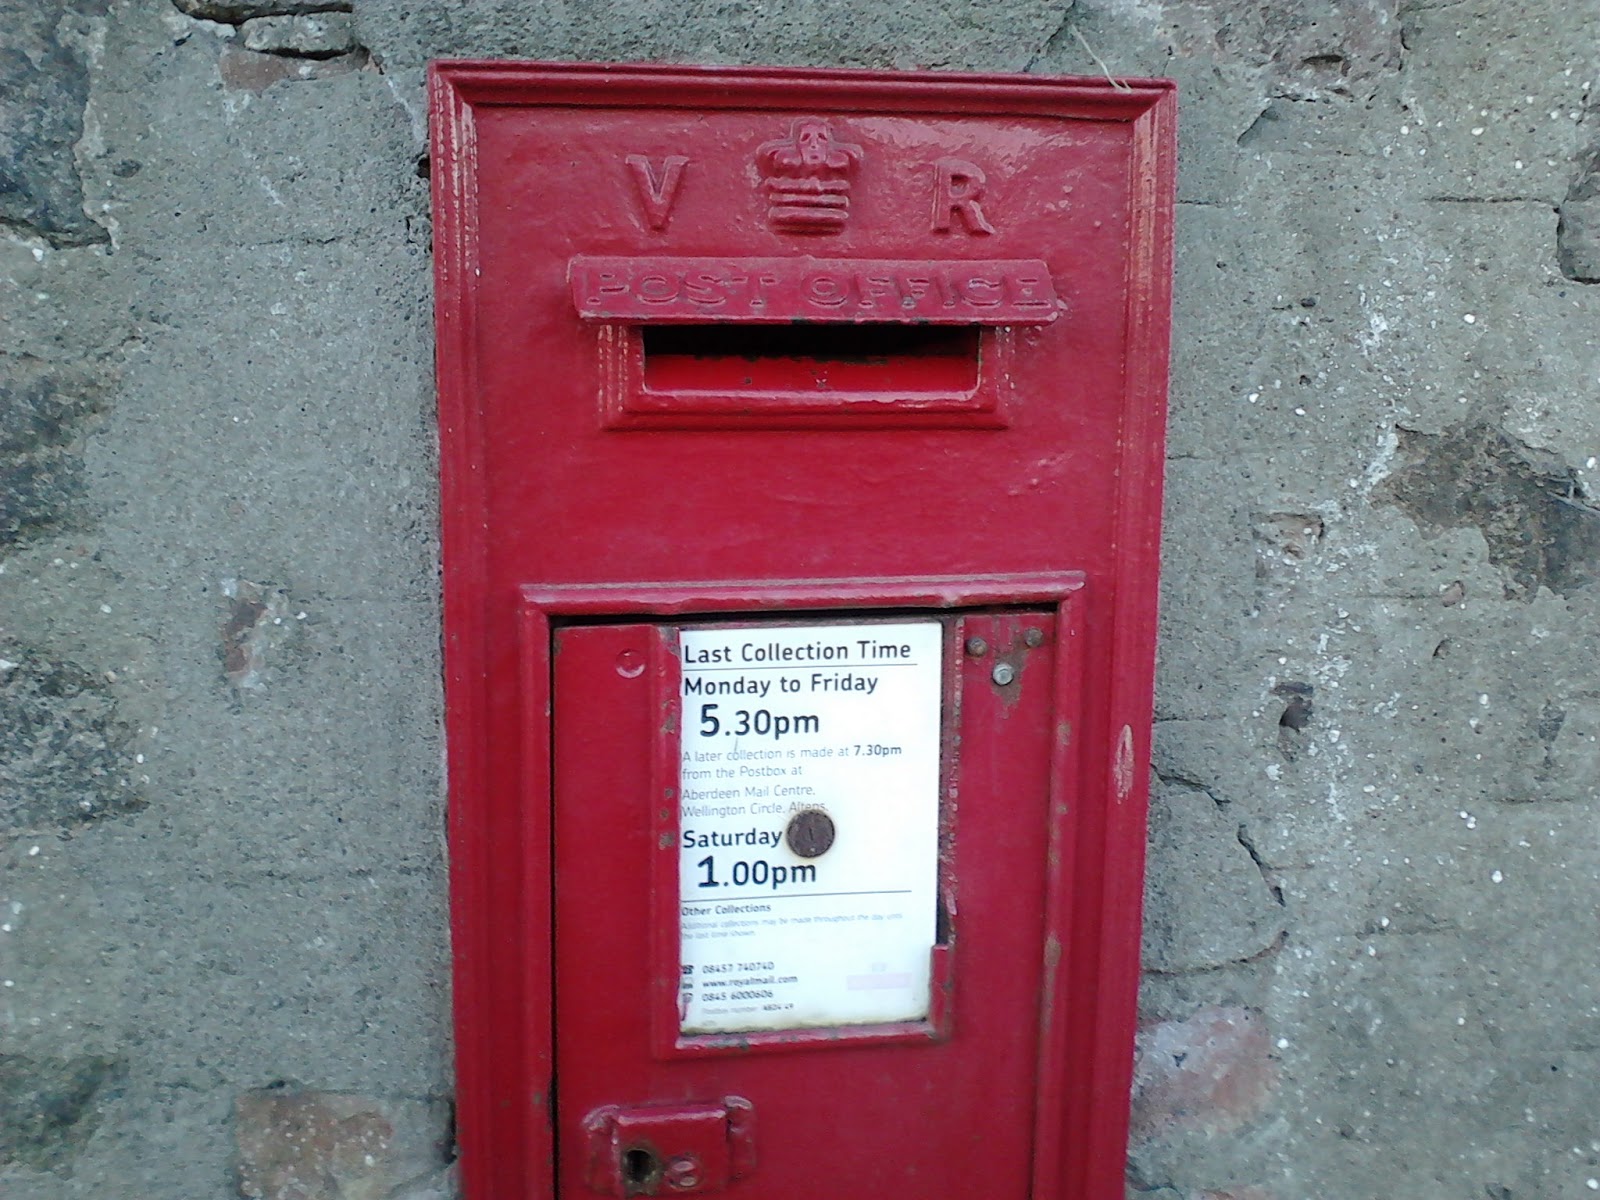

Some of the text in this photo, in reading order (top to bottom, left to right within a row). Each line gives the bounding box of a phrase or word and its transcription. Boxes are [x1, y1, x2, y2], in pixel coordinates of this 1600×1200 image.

[625, 155, 996, 235] V R
[585, 270, 1053, 310] POST OFFICE
[684, 640, 912, 664] Last Collection Time
[684, 673, 878, 697] Monday to Friday
[699, 703, 820, 740] 5.30pm
[682, 744, 902, 762] A later collection is made at 7.30pm
[683, 765, 803, 780] from the Postbox at
[682, 787, 740, 801] Aberdeen
[745, 786, 769, 799] Mail
[682, 804, 745, 818] Wellington
[683, 828, 782, 848] Saturday
[697, 855, 816, 889] 1.00pm
[681, 904, 771, 917] Other Collections
[702, 974, 799, 988] www.royalmail.com
